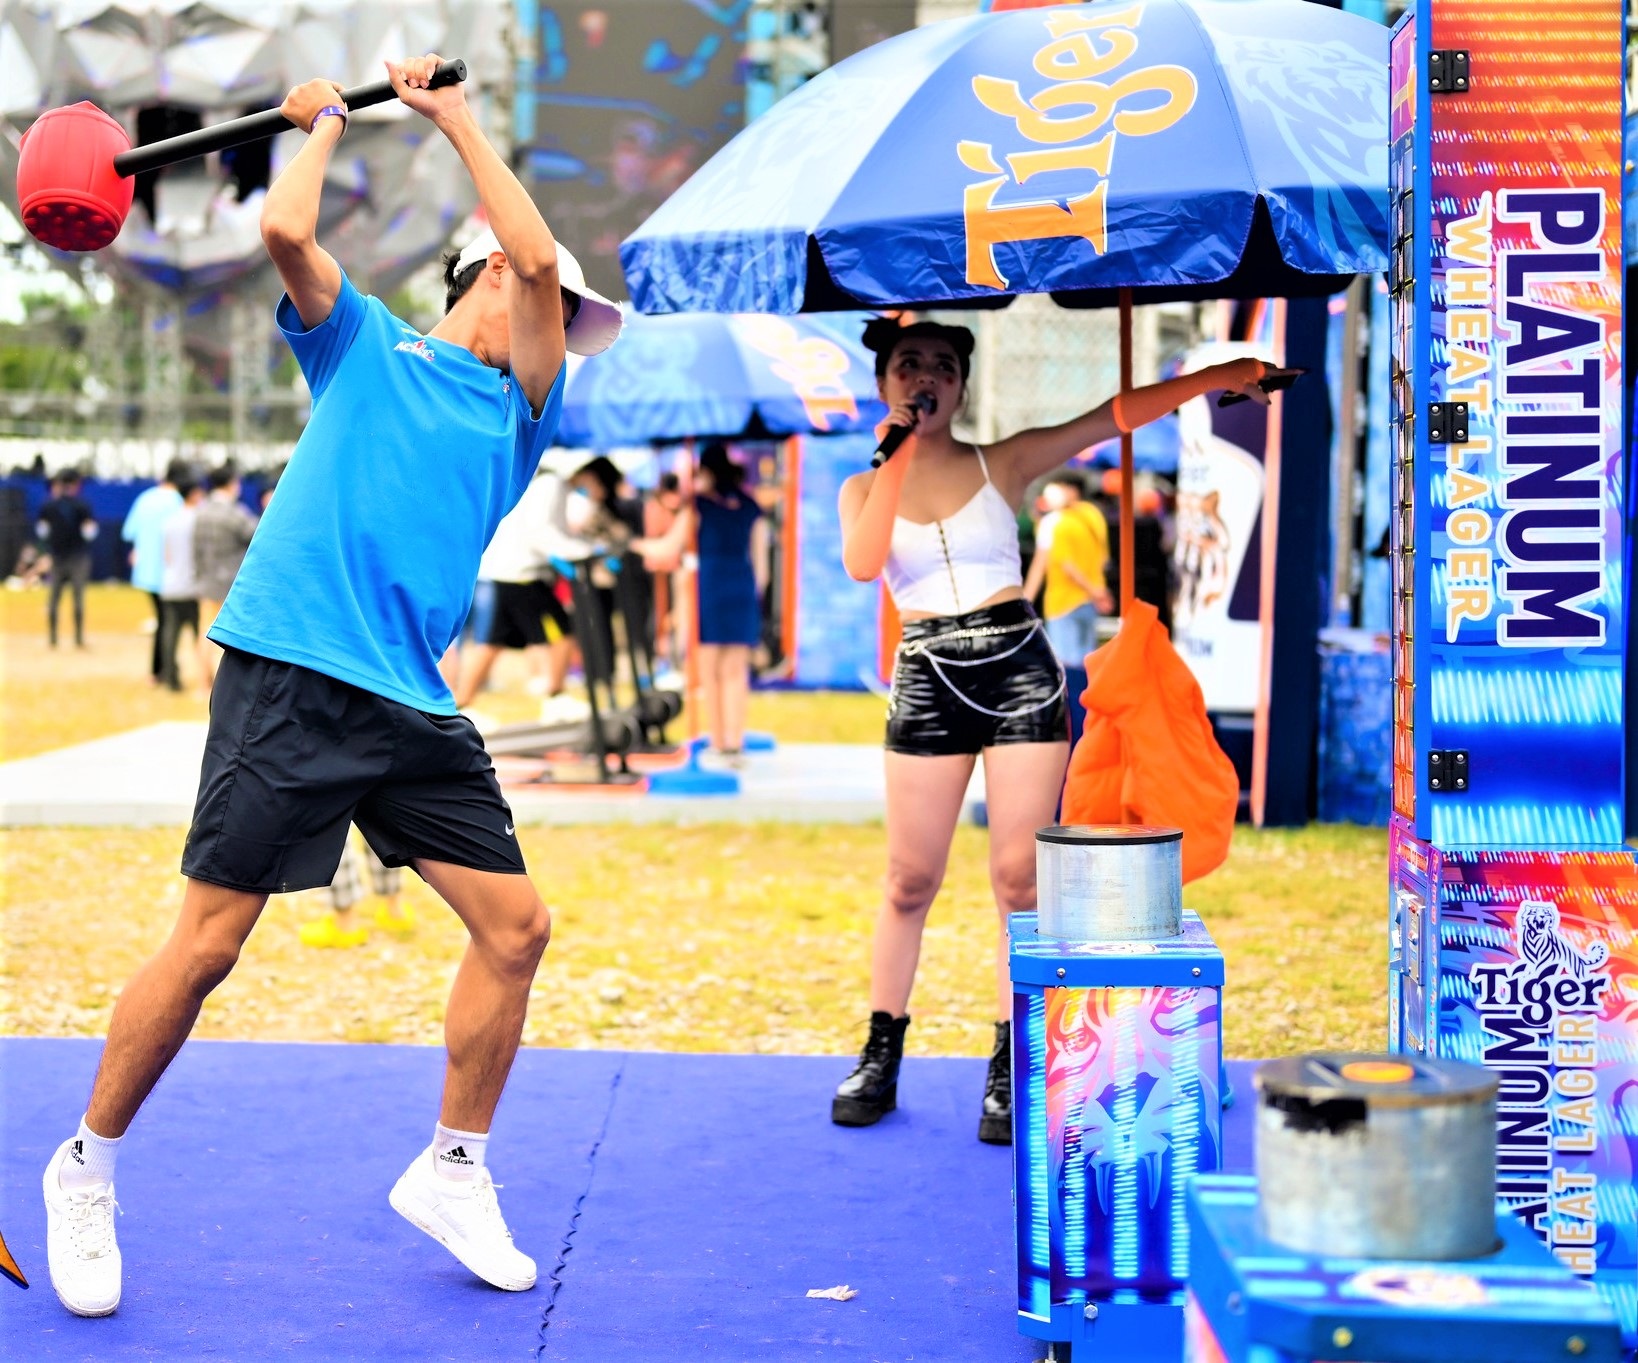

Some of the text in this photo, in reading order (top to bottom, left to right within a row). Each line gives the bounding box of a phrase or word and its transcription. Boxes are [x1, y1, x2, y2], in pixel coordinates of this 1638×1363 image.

[958, 2, 1198, 291] Tiger
[1450, 202, 1488, 637] WHEAT LAGER
[1507, 192, 1601, 638] PLATINUM
[1475, 964, 1607, 1024] Tiger
[440, 1154, 474, 1165] adidas
[1485, 1018, 1549, 1242] ATINUM
[1557, 1015, 1593, 1271] HEAT LAGER
